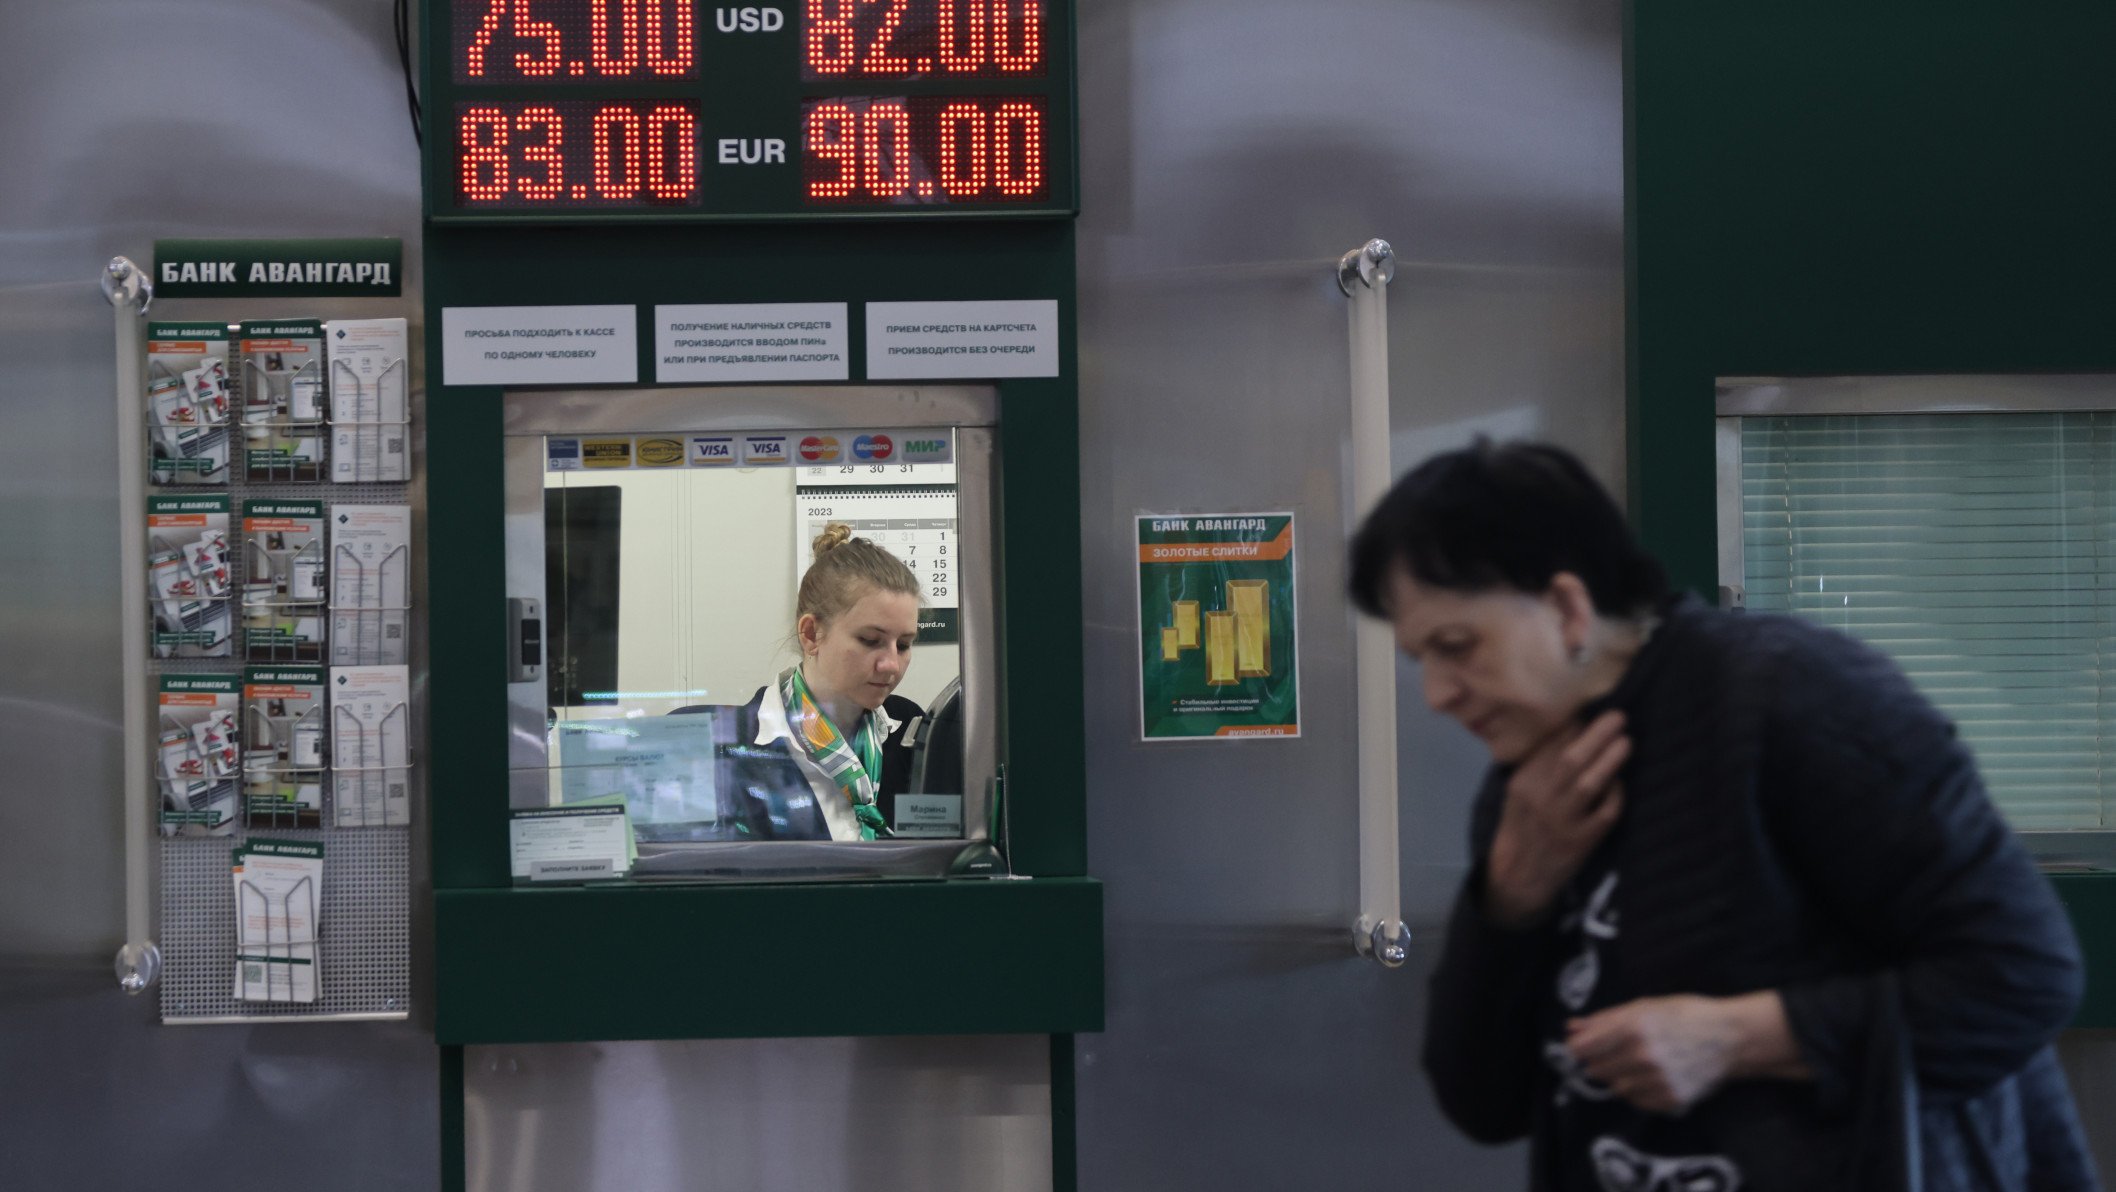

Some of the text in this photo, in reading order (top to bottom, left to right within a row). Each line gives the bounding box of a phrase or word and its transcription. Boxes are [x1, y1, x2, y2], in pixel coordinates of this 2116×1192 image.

[716, 7, 784, 33] USD
[468, 0, 692, 76] 75.00
[808, 0, 1039, 74] 82.00
[461, 106, 696, 200] 83.00
[717, 138, 786, 164] EUR
[809, 104, 1040, 197] 90.00
[161, 262, 392, 285] БАНК АВАНГАРД
[671, 321, 832, 331] ПОЛУЧЕНИЕ НАЛИЧНЫХ СРЕДСТВ
[886, 323, 1037, 333] ПРИЕМ СРЕДСТВ НА КАРТСЧЕТА
[465, 327, 615, 338] ПРОСЬБА ПОДХОДИТЬ К КАССЕ
[674, 338, 827, 348] ПРОИЗВОДИТСЯ ВВОДОМ ПИНа
[484, 350, 596, 360] ПО ОДНОМУ ЧЕЛОВЕКУ
[888, 345, 1036, 356] ПРОИЗВОДИТСЯ БЕЗ ОЧЕРЕДИ
[664, 354, 840, 364] ИЛИ ПРИ ПРЕДЪЯВЛЕНИИ ПАСПОРТА
[699, 444, 729, 456] VISA
[752, 443, 781, 453] VISA
[857, 442, 889, 451] Maestro
[905, 439, 946, 453] МИР
[840, 465, 854, 474] 29
[869, 464, 884, 473] 30
[900, 464, 914, 473] 31
[808, 508, 833, 516] 2023
[1152, 519, 1267, 532] БАНК АВАНГАРД
[940, 532, 945, 541] 1
[909, 546, 947, 555] 7 8
[1153, 546, 1258, 557] ЗОЛОТЫЕ СЛИТКИ
[933, 560, 947, 568] 15
[932, 573, 947, 583] 22
[932, 587, 947, 597] 29
[916, 621, 946, 629] ngard.ru
[910, 805, 947, 814] Марина
